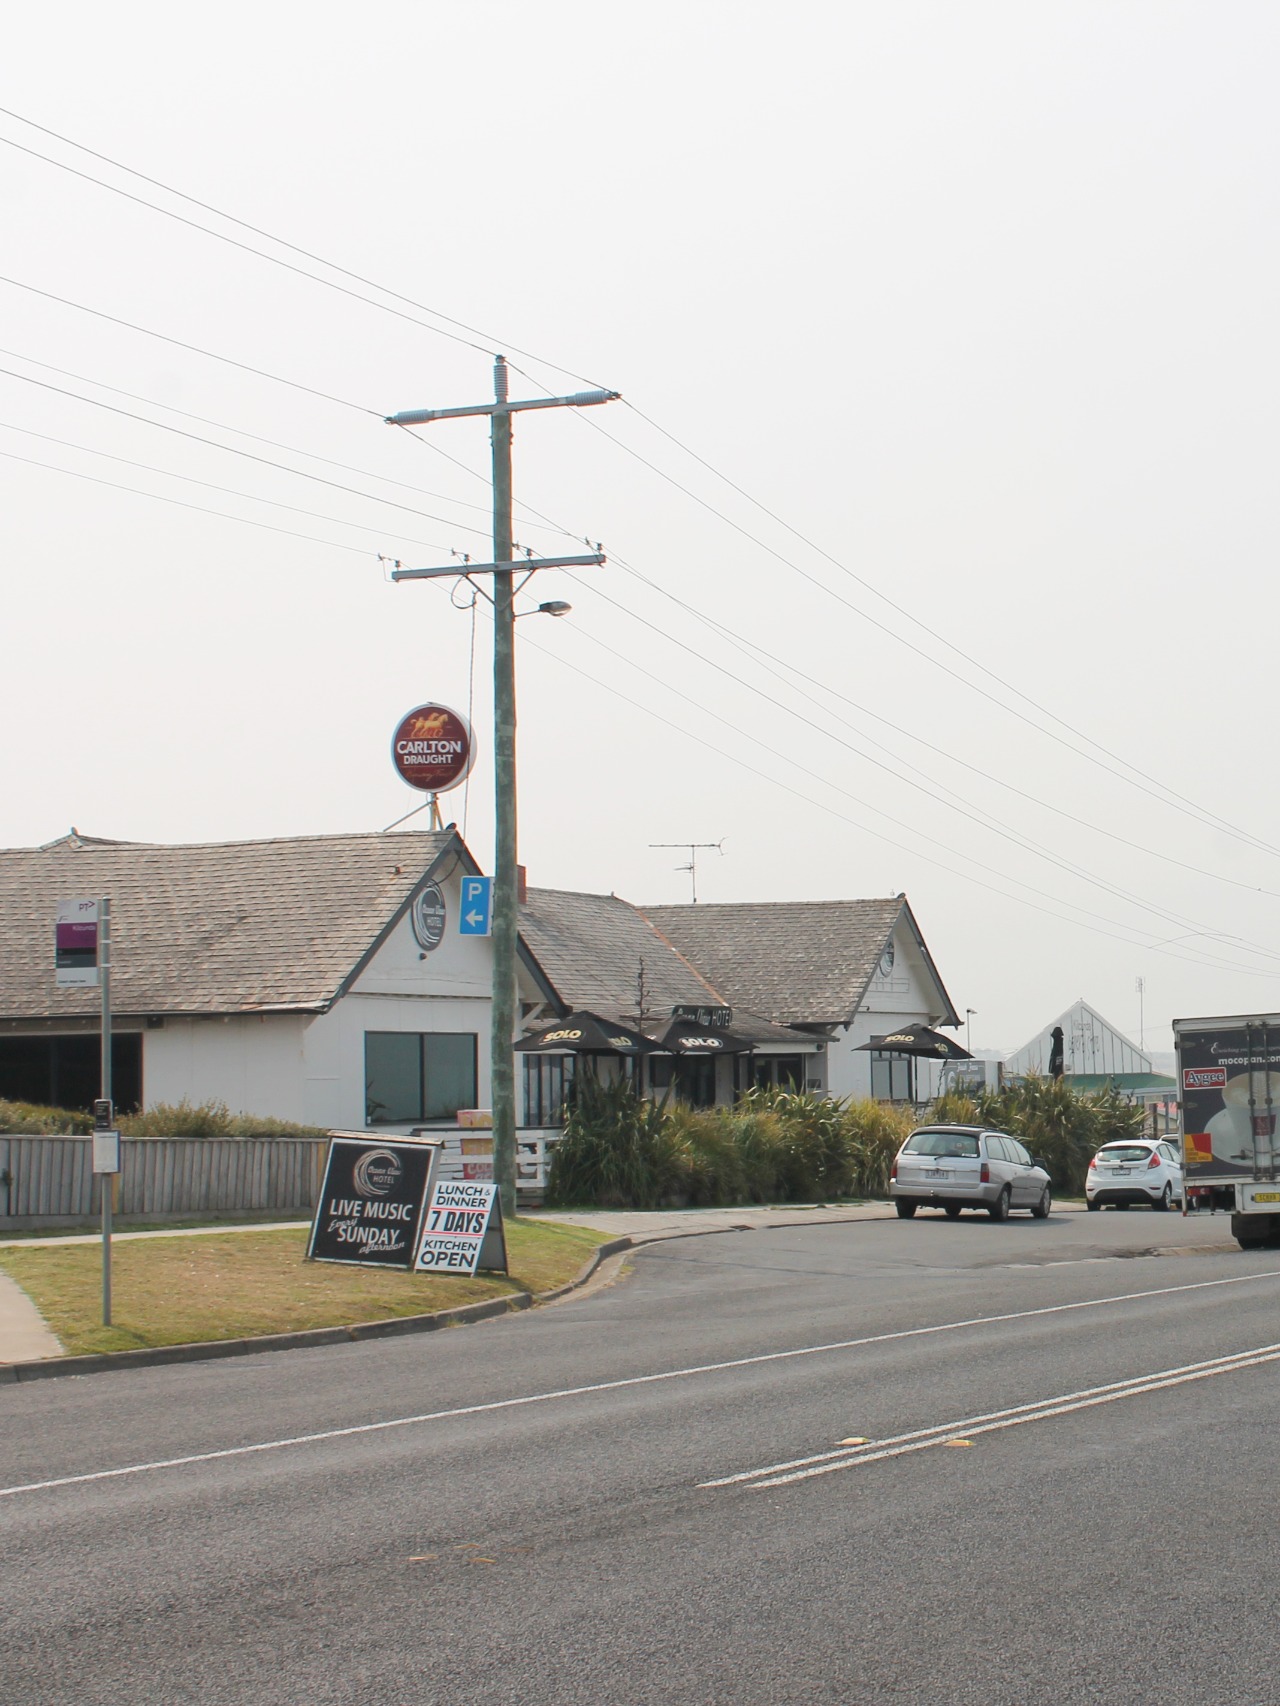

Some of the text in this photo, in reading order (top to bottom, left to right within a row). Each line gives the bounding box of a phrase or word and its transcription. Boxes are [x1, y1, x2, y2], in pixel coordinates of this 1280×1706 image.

[397, 740, 462, 754] CARLTON
[403, 755, 453, 764] DRAUGHT
[468, 883, 482, 901] P
[543, 1029, 582, 1042] SOLO
[885, 1034, 915, 1042] SOLO
[681, 1037, 720, 1048] SOLO
[1186, 1071, 1224, 1086] Aygee
[372, 1175, 395, 1184] HOTEL
[437, 1185, 483, 1196] LUNCH
[436, 1196, 487, 1208] DINNER
[329, 1199, 413, 1221] LIVE MUSIC
[327, 1218, 358, 1232] Every
[430, 1210, 485, 1234] 7 DAYS
[337, 1226, 400, 1246] SUNDAY
[358, 1242, 405, 1254] afternoon
[424, 1239, 478, 1252] KITCHEN
[420, 1250, 475, 1268] OPEN
